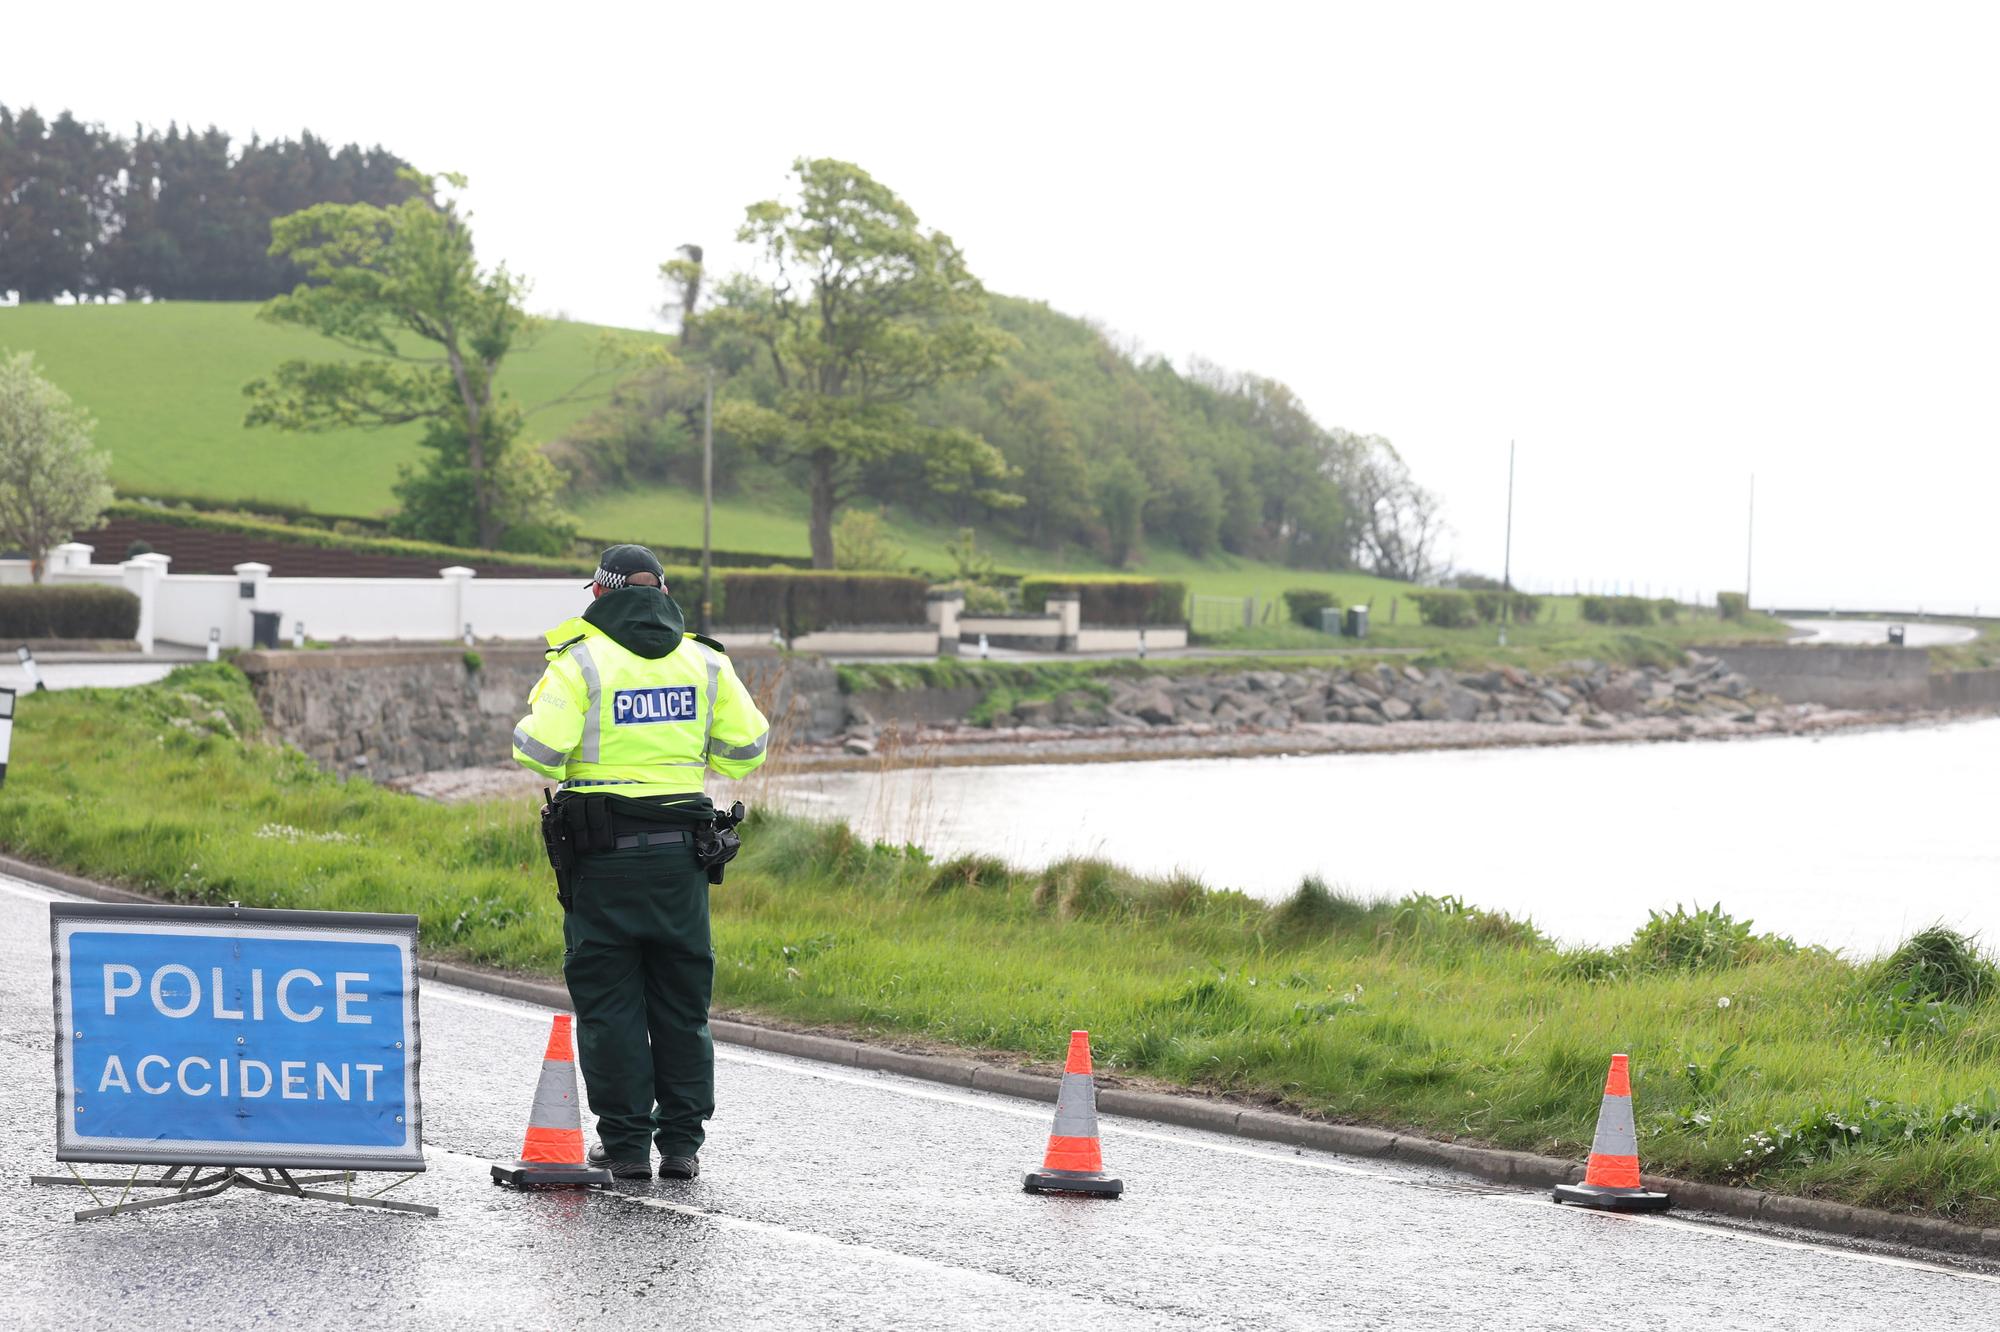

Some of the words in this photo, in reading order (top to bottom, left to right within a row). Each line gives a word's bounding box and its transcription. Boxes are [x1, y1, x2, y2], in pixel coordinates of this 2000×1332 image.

[617, 691, 693, 720] POLICE
[103, 963, 372, 1024] POLICE
[98, 1054, 383, 1101] ACCIDENT
